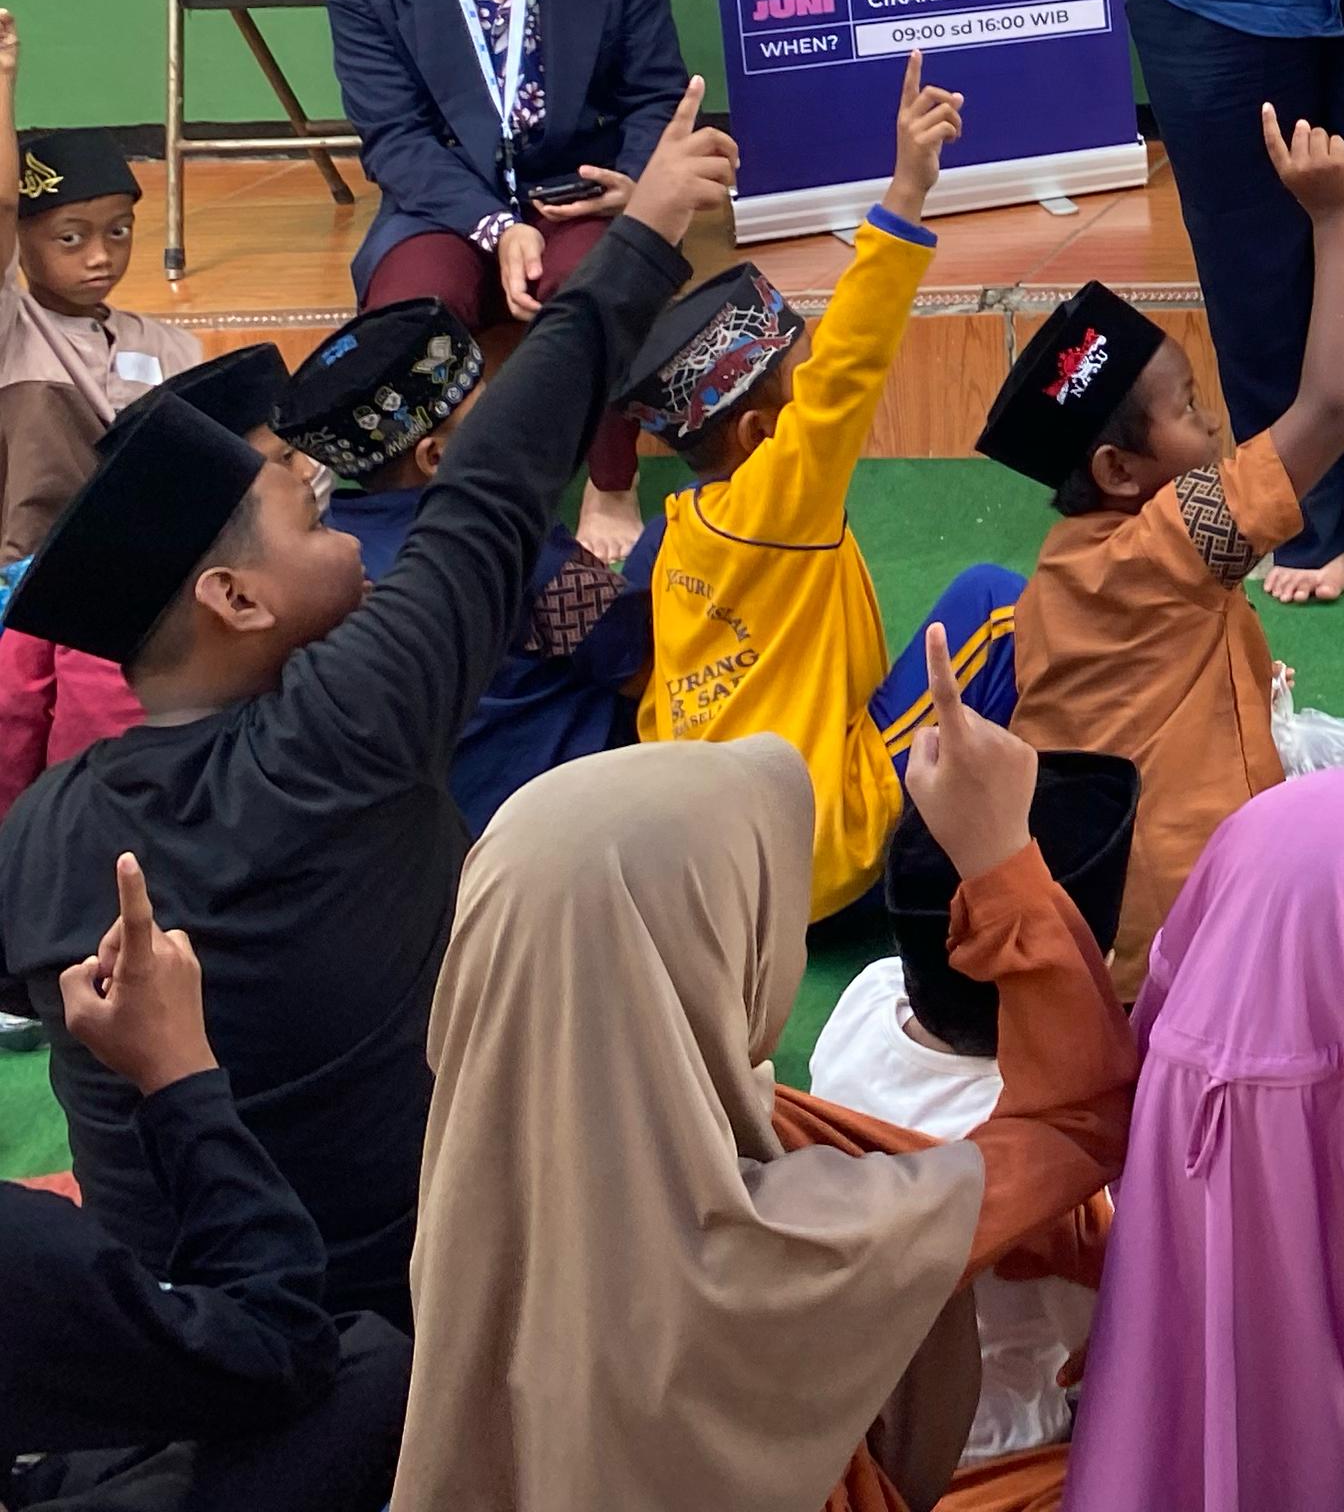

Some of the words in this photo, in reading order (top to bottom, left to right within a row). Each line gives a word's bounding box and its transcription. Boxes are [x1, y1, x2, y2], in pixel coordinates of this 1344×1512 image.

[892, 22, 946, 44] 09:00
[950, 19, 973, 38] sd
[977, 13, 1026, 35] 16:00
[1029, 8, 1070, 28] WIB
[760, 35, 839, 59] WHEN?
